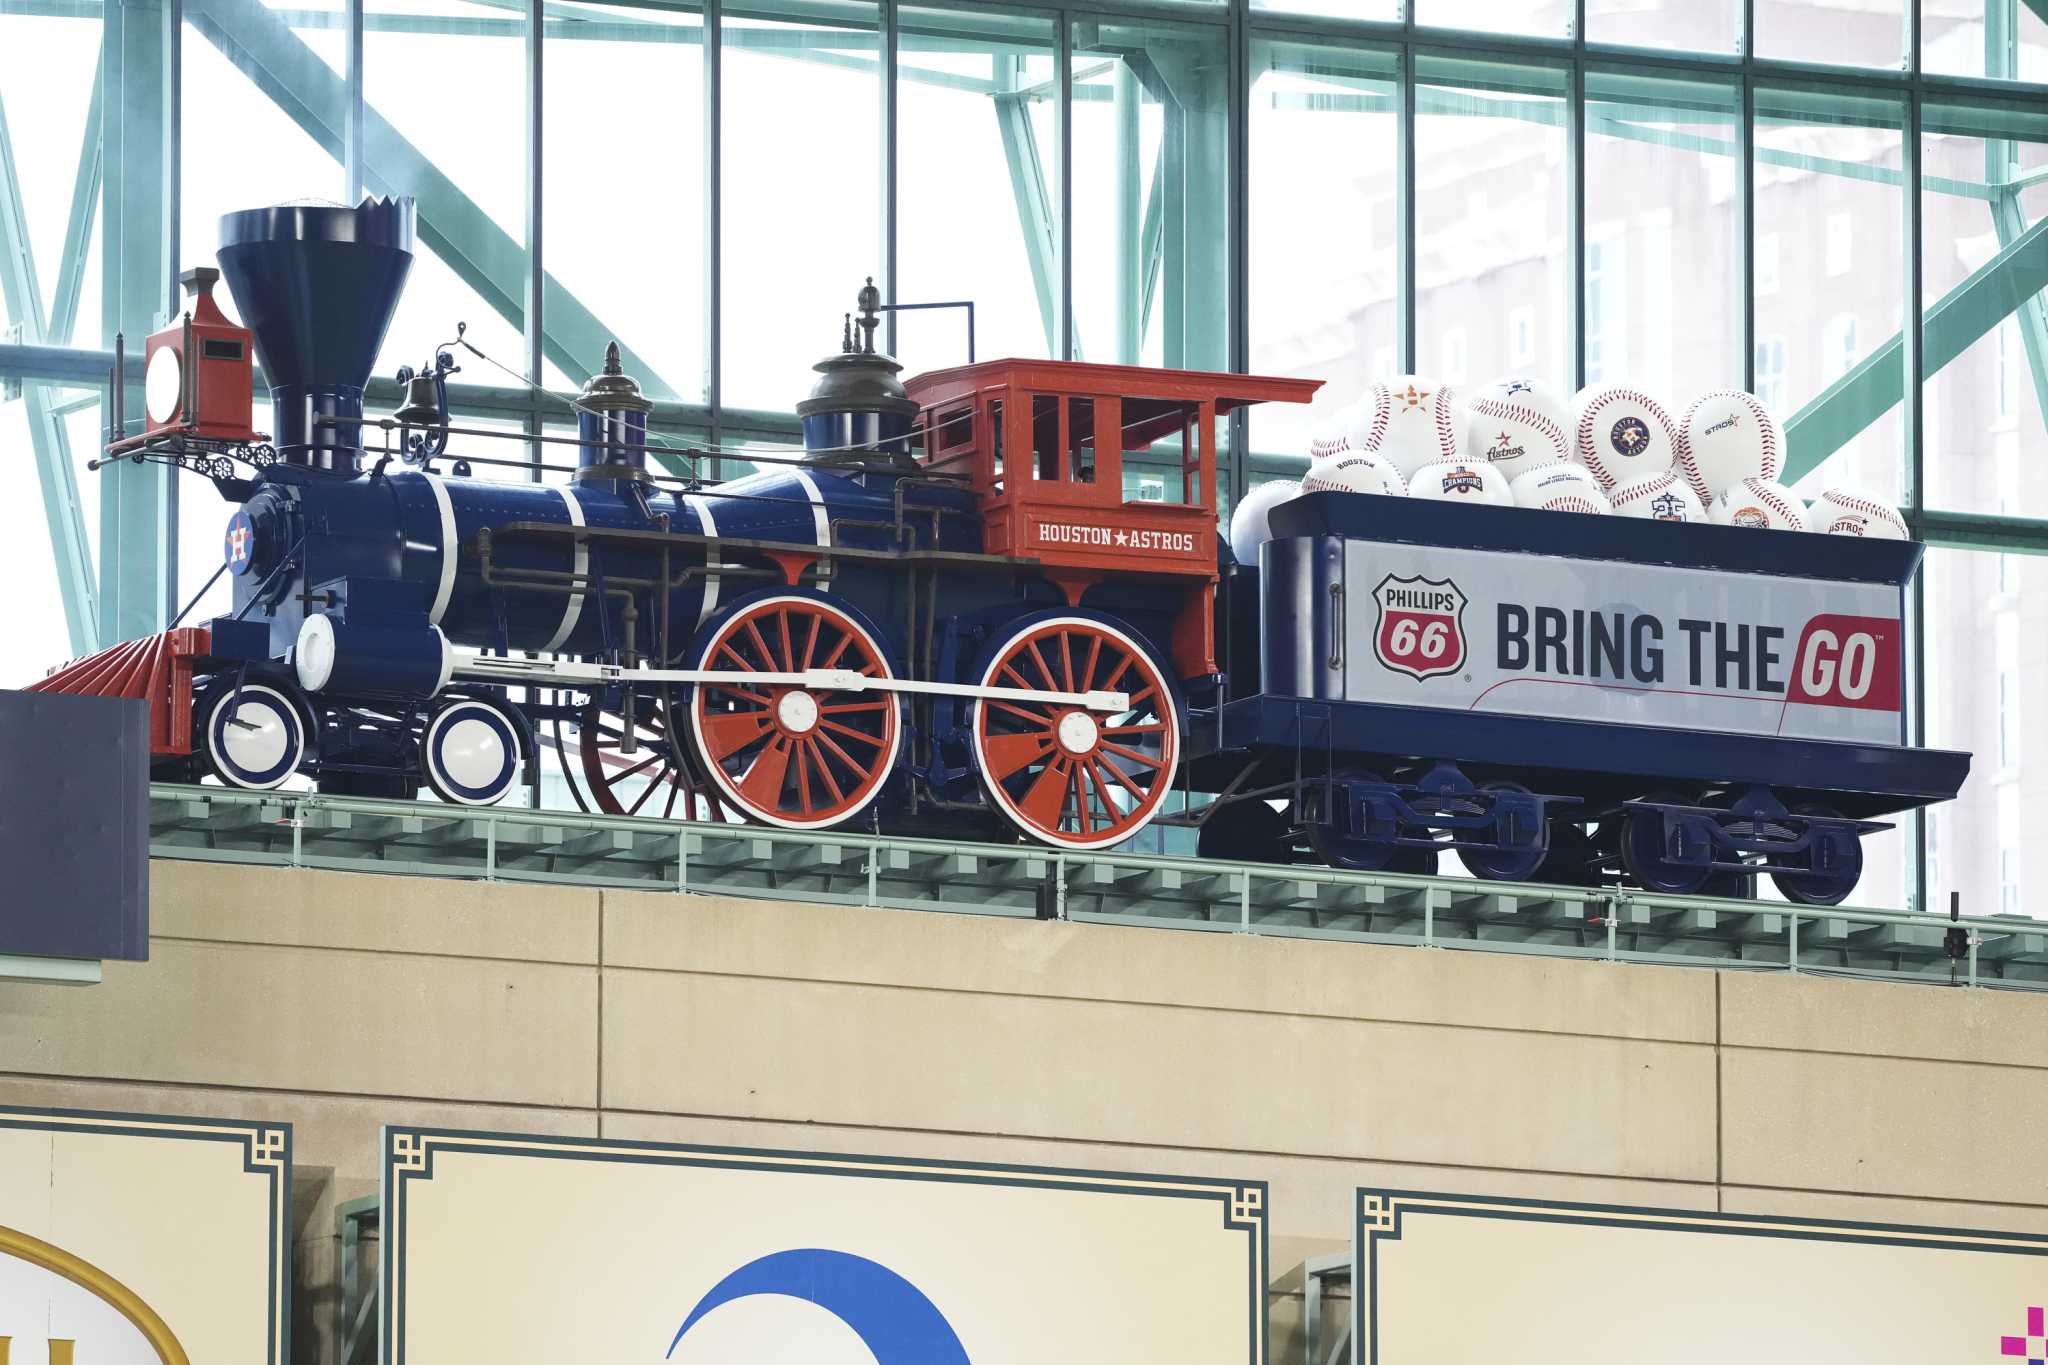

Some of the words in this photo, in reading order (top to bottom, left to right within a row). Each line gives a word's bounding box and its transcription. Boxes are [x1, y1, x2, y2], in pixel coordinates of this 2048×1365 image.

[1336, 459, 1376, 470] HOUSTON
[1486, 445, 1526, 462] Astros
[1443, 477, 1482, 489] CHAMPIONS
[230, 527, 247, 563] H
[1039, 523, 1112, 545] HOUSTON
[1129, 530, 1193, 551] ASTROS
[1386, 588, 1454, 612] PHILLIPS
[1390, 618, 1449, 659] 66
[1497, 602, 1664, 683] BRING
[1678, 618, 1785, 693] THE
